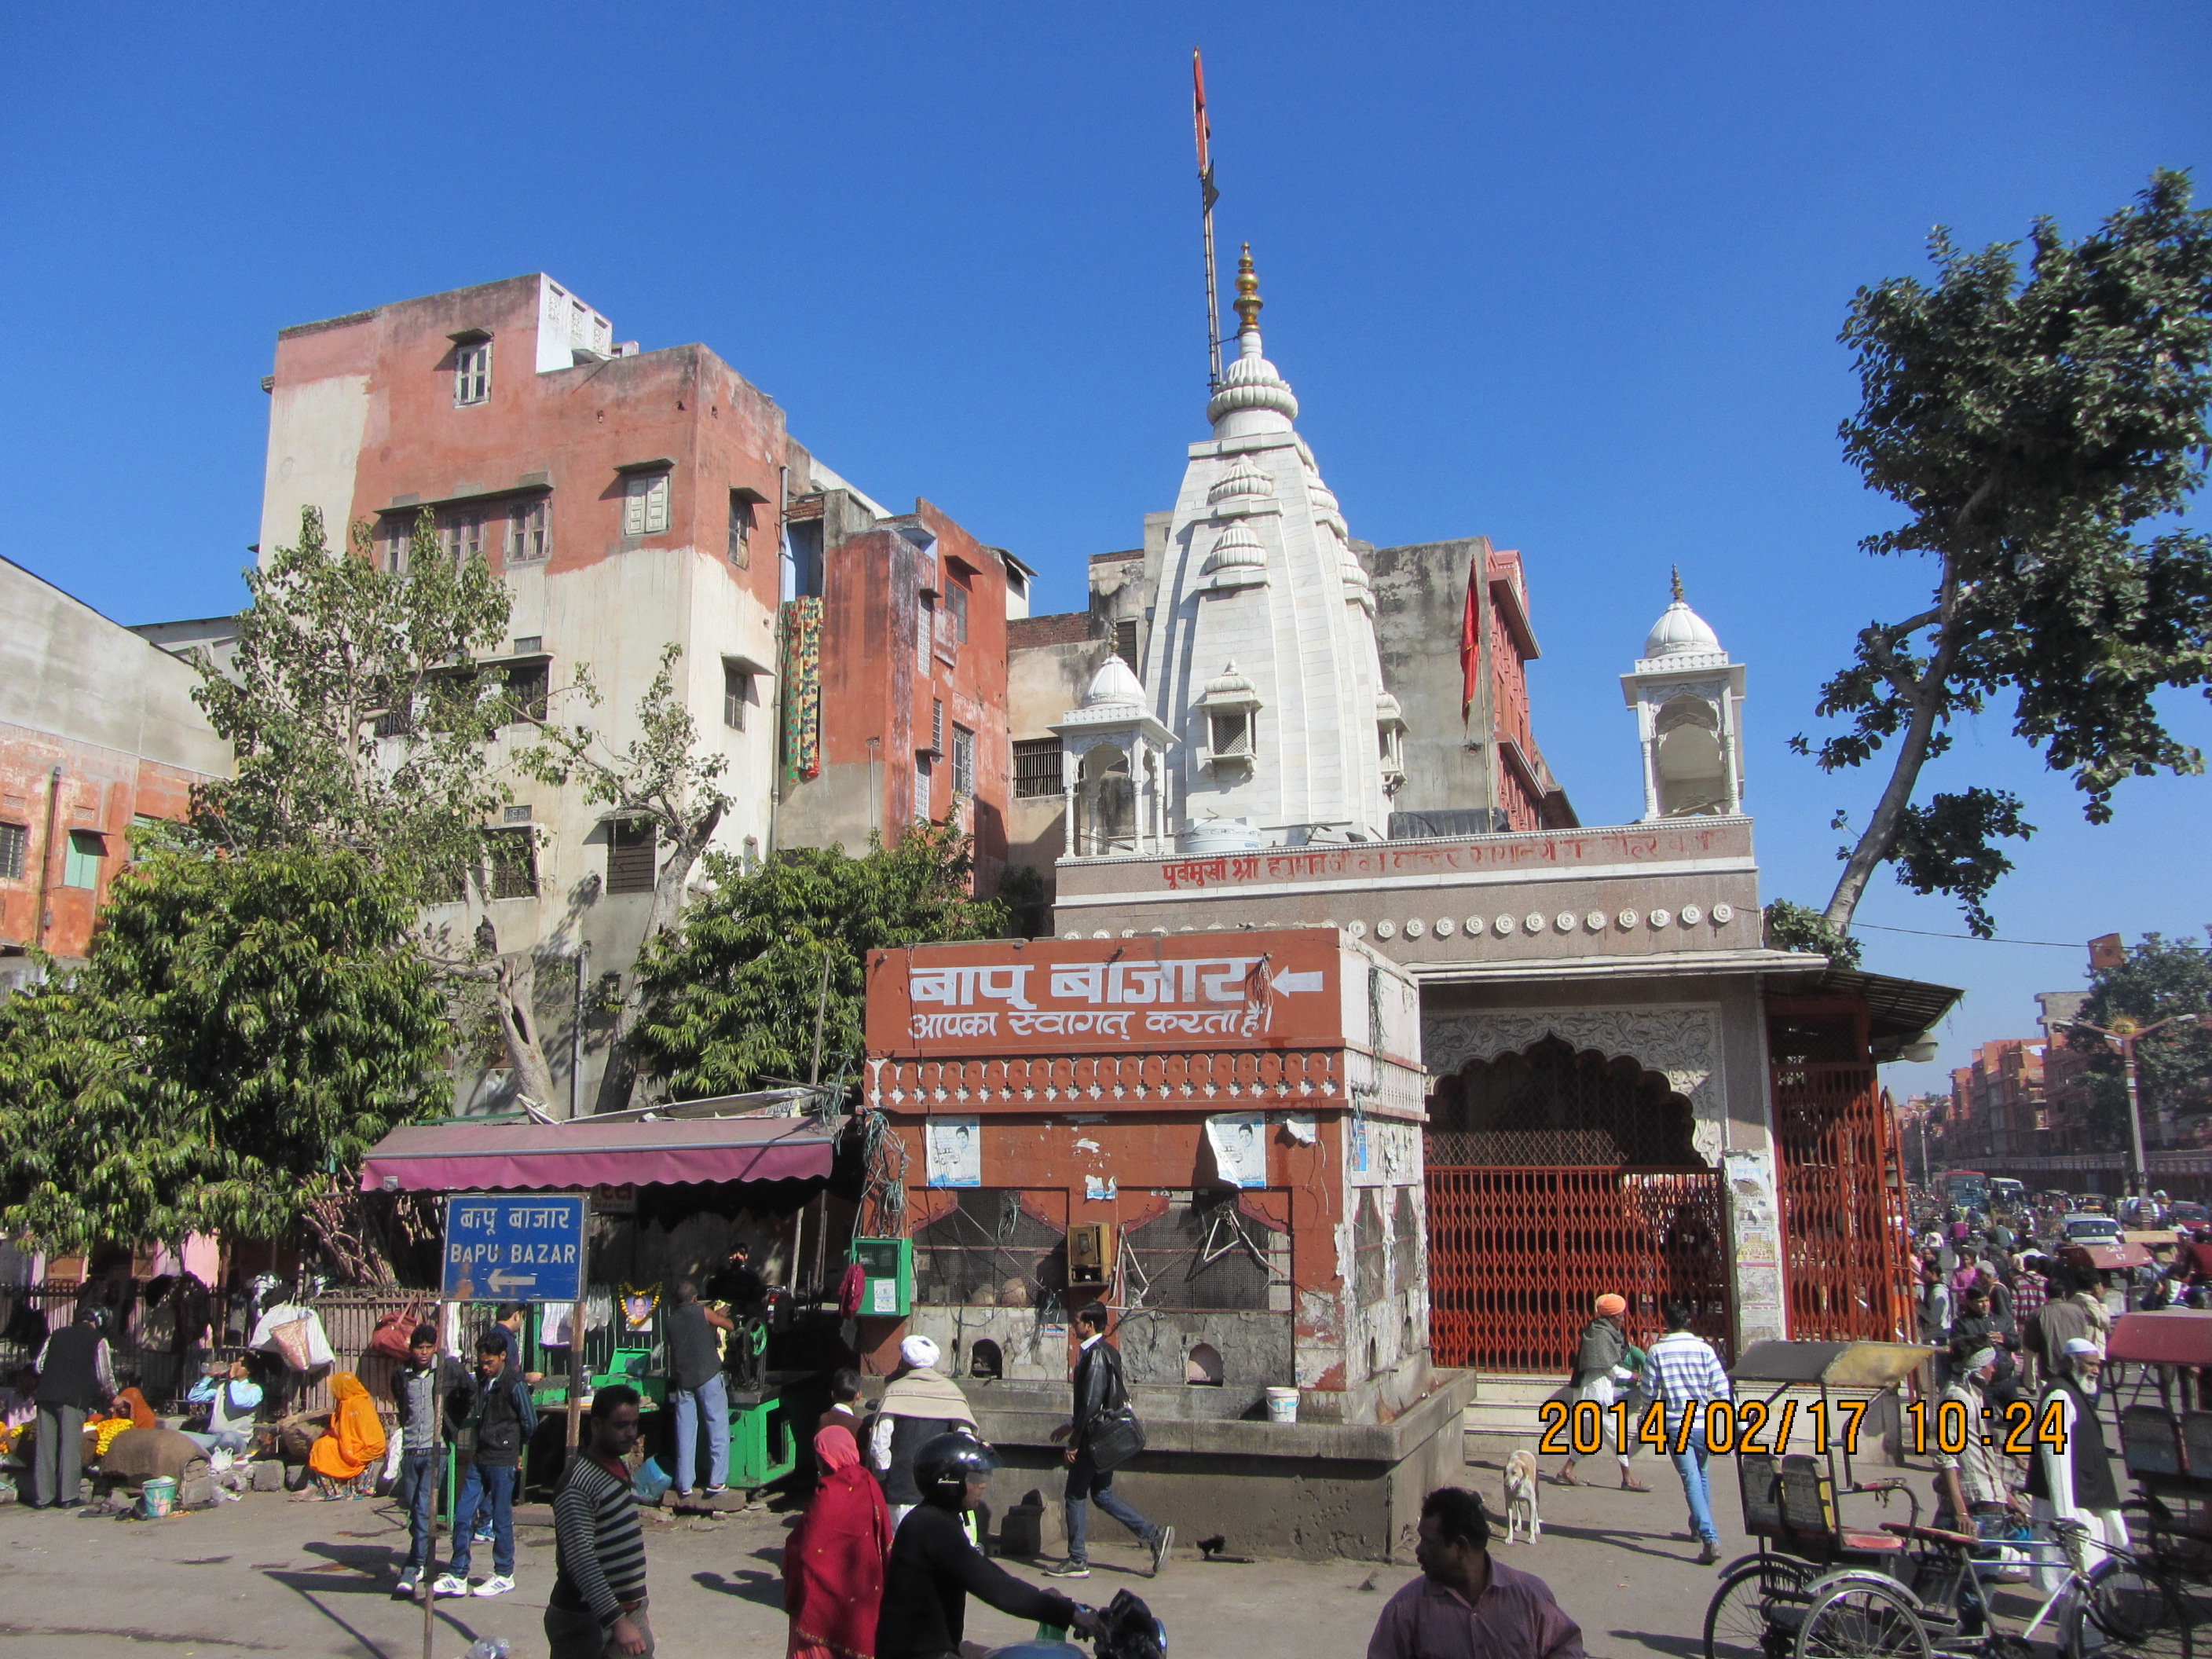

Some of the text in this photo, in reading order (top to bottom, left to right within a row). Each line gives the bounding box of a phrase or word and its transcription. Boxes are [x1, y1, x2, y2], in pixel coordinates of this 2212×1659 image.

[910, 956, 1265, 1010] बापू बाजार
[907, 1012, 999, 1039] आपका
[460, 1207, 571, 1236] बापू बाजार
[450, 1243, 577, 1264] BAPU BAZAR
